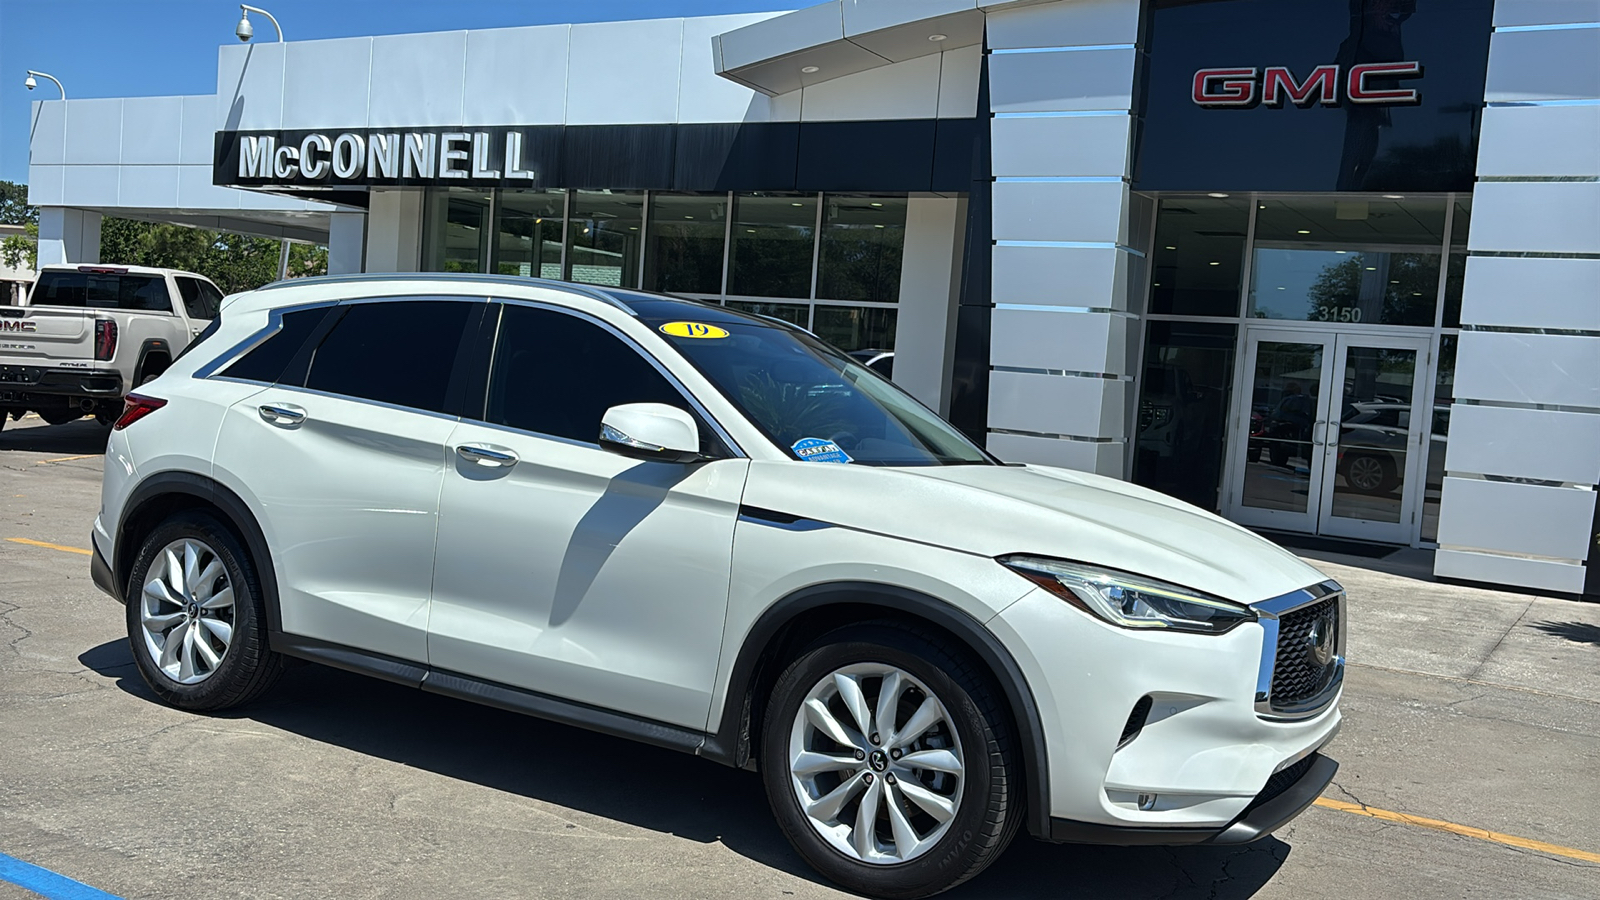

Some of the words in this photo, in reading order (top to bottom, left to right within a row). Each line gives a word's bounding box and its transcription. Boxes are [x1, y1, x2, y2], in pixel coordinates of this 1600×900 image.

[1191, 61, 1420, 106] GMC
[238, 131, 535, 180] McCONNELL
[1318, 306, 1362, 323] 3150
[0, 320, 37, 333] MC
[683, 324, 709, 336] 19
